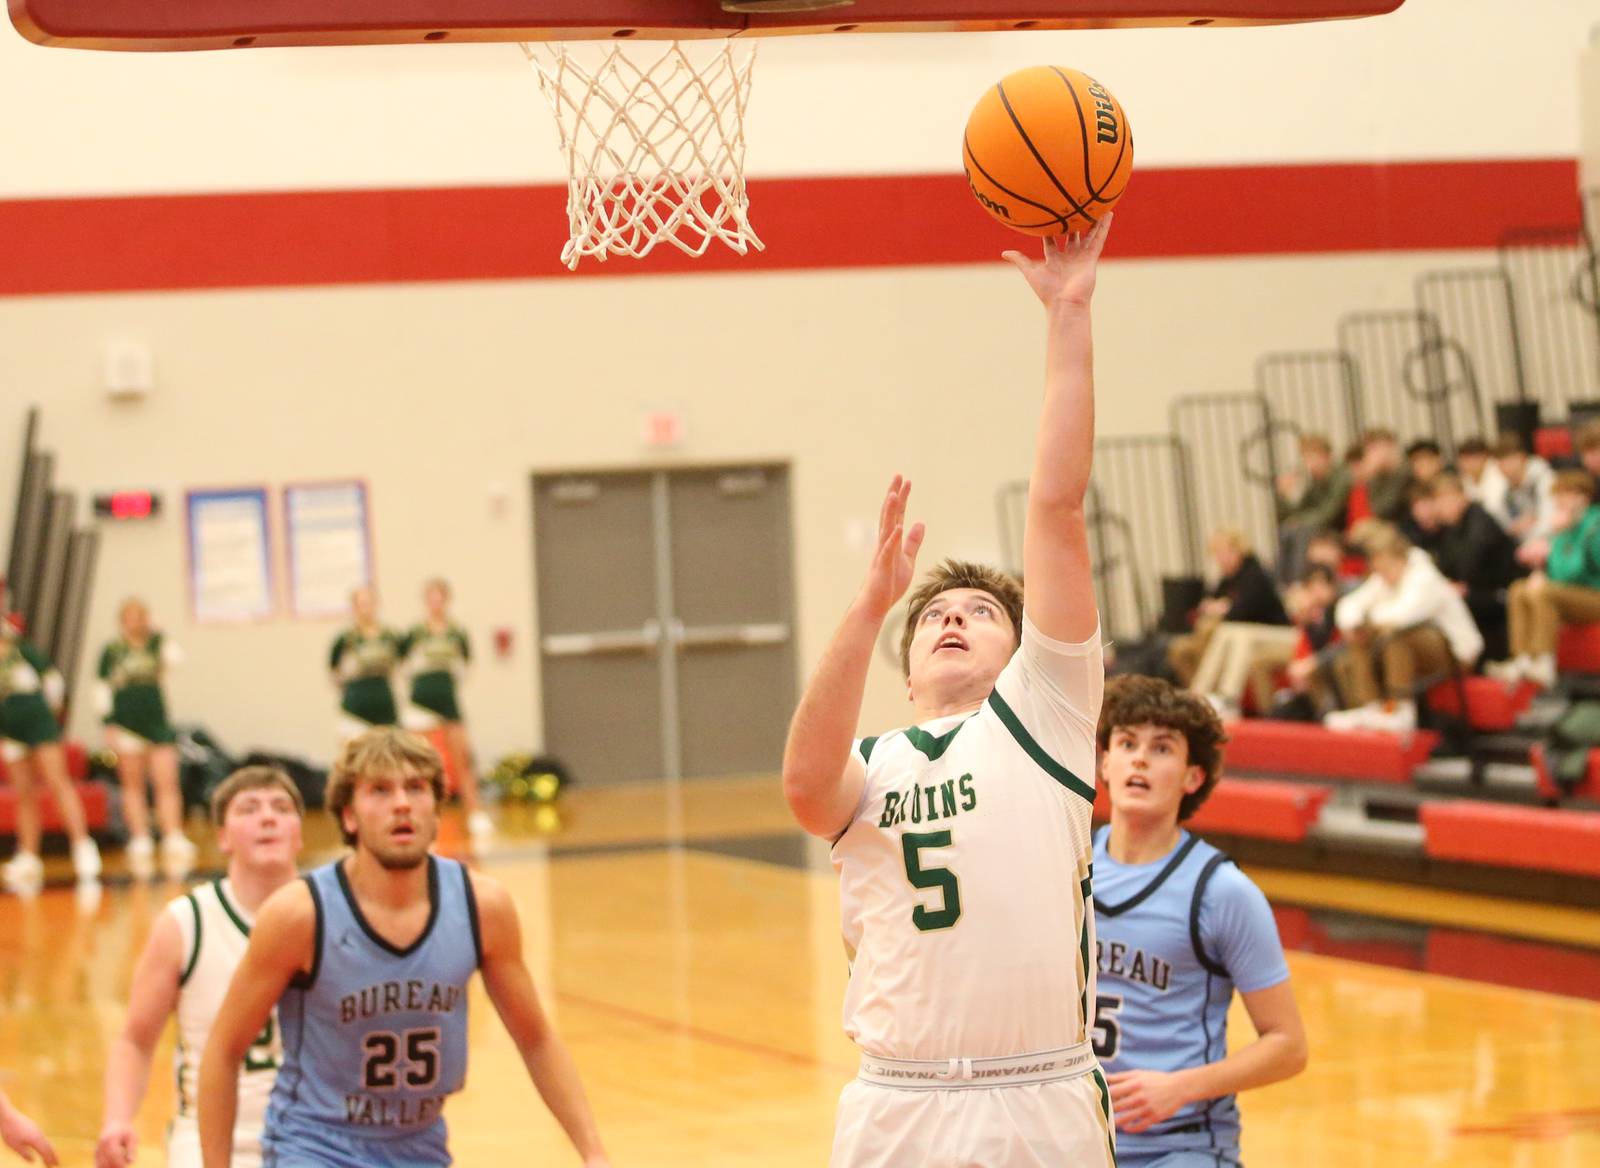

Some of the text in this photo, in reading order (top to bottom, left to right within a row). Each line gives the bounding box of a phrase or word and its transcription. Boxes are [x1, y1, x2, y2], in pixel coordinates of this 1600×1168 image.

[901, 829, 962, 932] 5
[1096, 940, 1171, 991] REAU
[363, 1029, 439, 1088] 25
